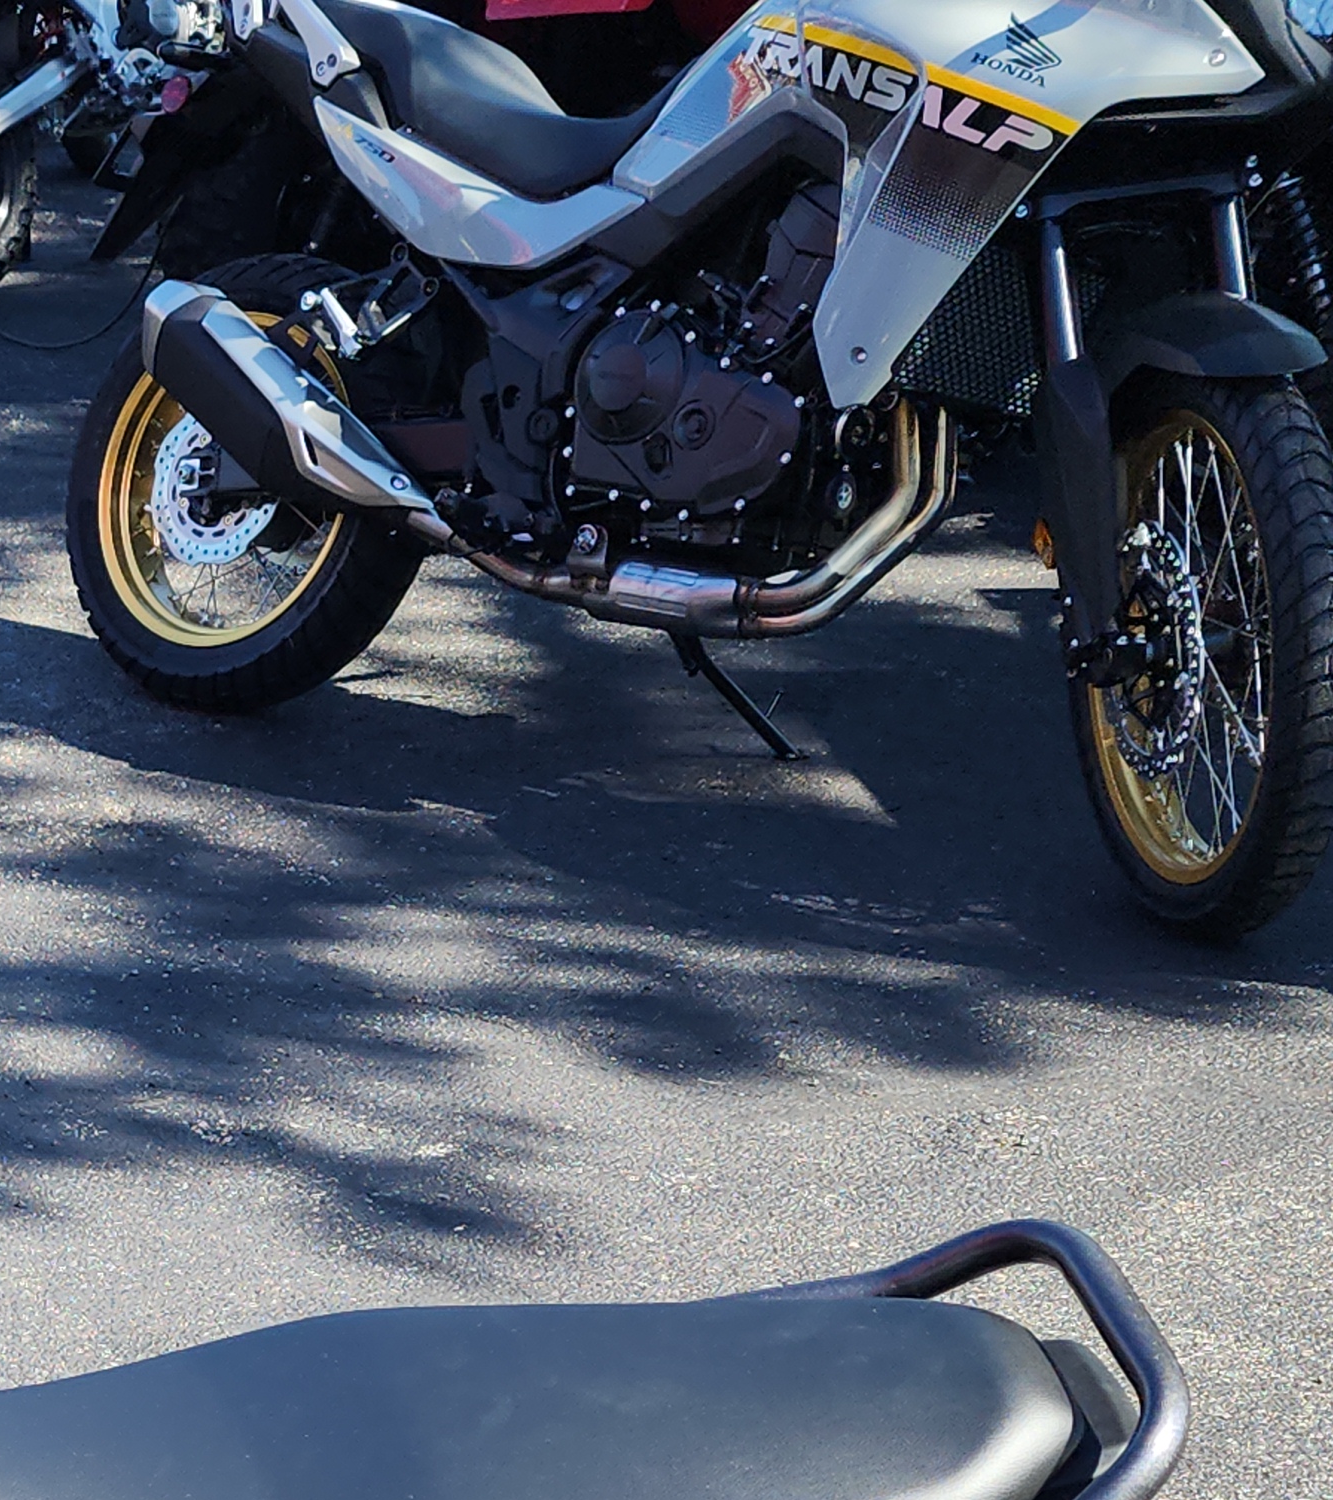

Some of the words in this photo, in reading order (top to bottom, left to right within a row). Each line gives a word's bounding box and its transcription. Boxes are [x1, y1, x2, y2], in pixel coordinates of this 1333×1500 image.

[970, 51, 1046, 88] HONDA
[743, 24, 1053, 153] TRANSALP
[353, 134, 396, 164] 750
